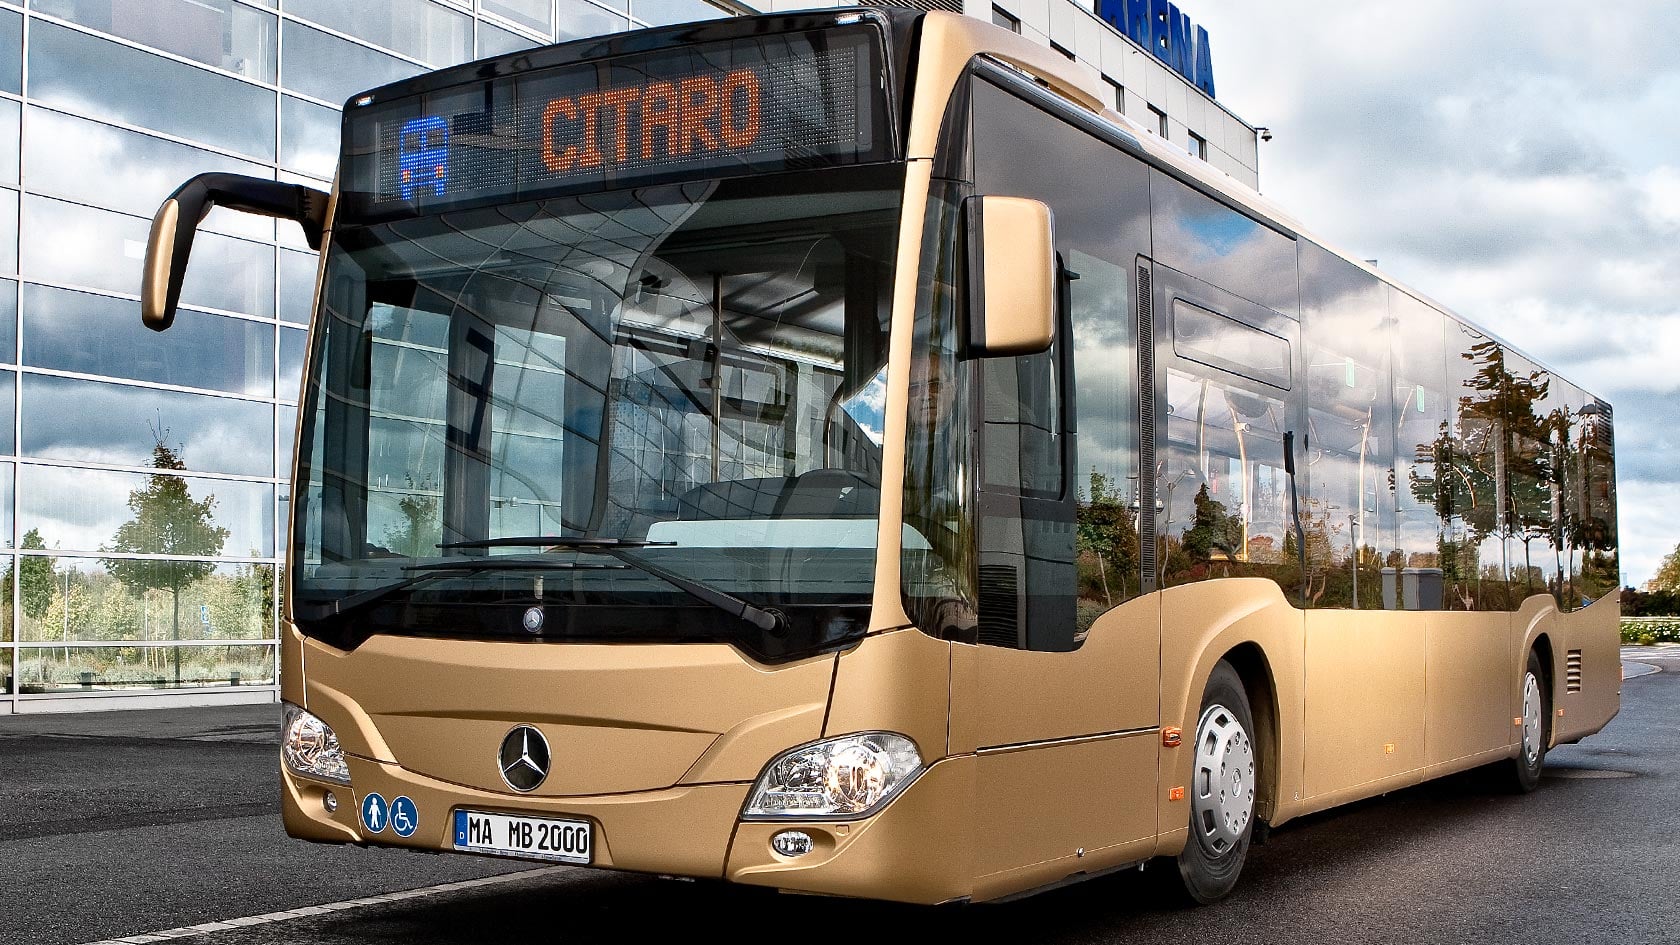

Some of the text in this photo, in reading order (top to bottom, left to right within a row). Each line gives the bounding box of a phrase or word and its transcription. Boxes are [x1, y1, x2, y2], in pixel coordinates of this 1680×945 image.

[541, 68, 762, 173] CITARO
[468, 816, 493, 845] MA
[508, 820, 533, 849] MB
[537, 823, 588, 854] 2000
